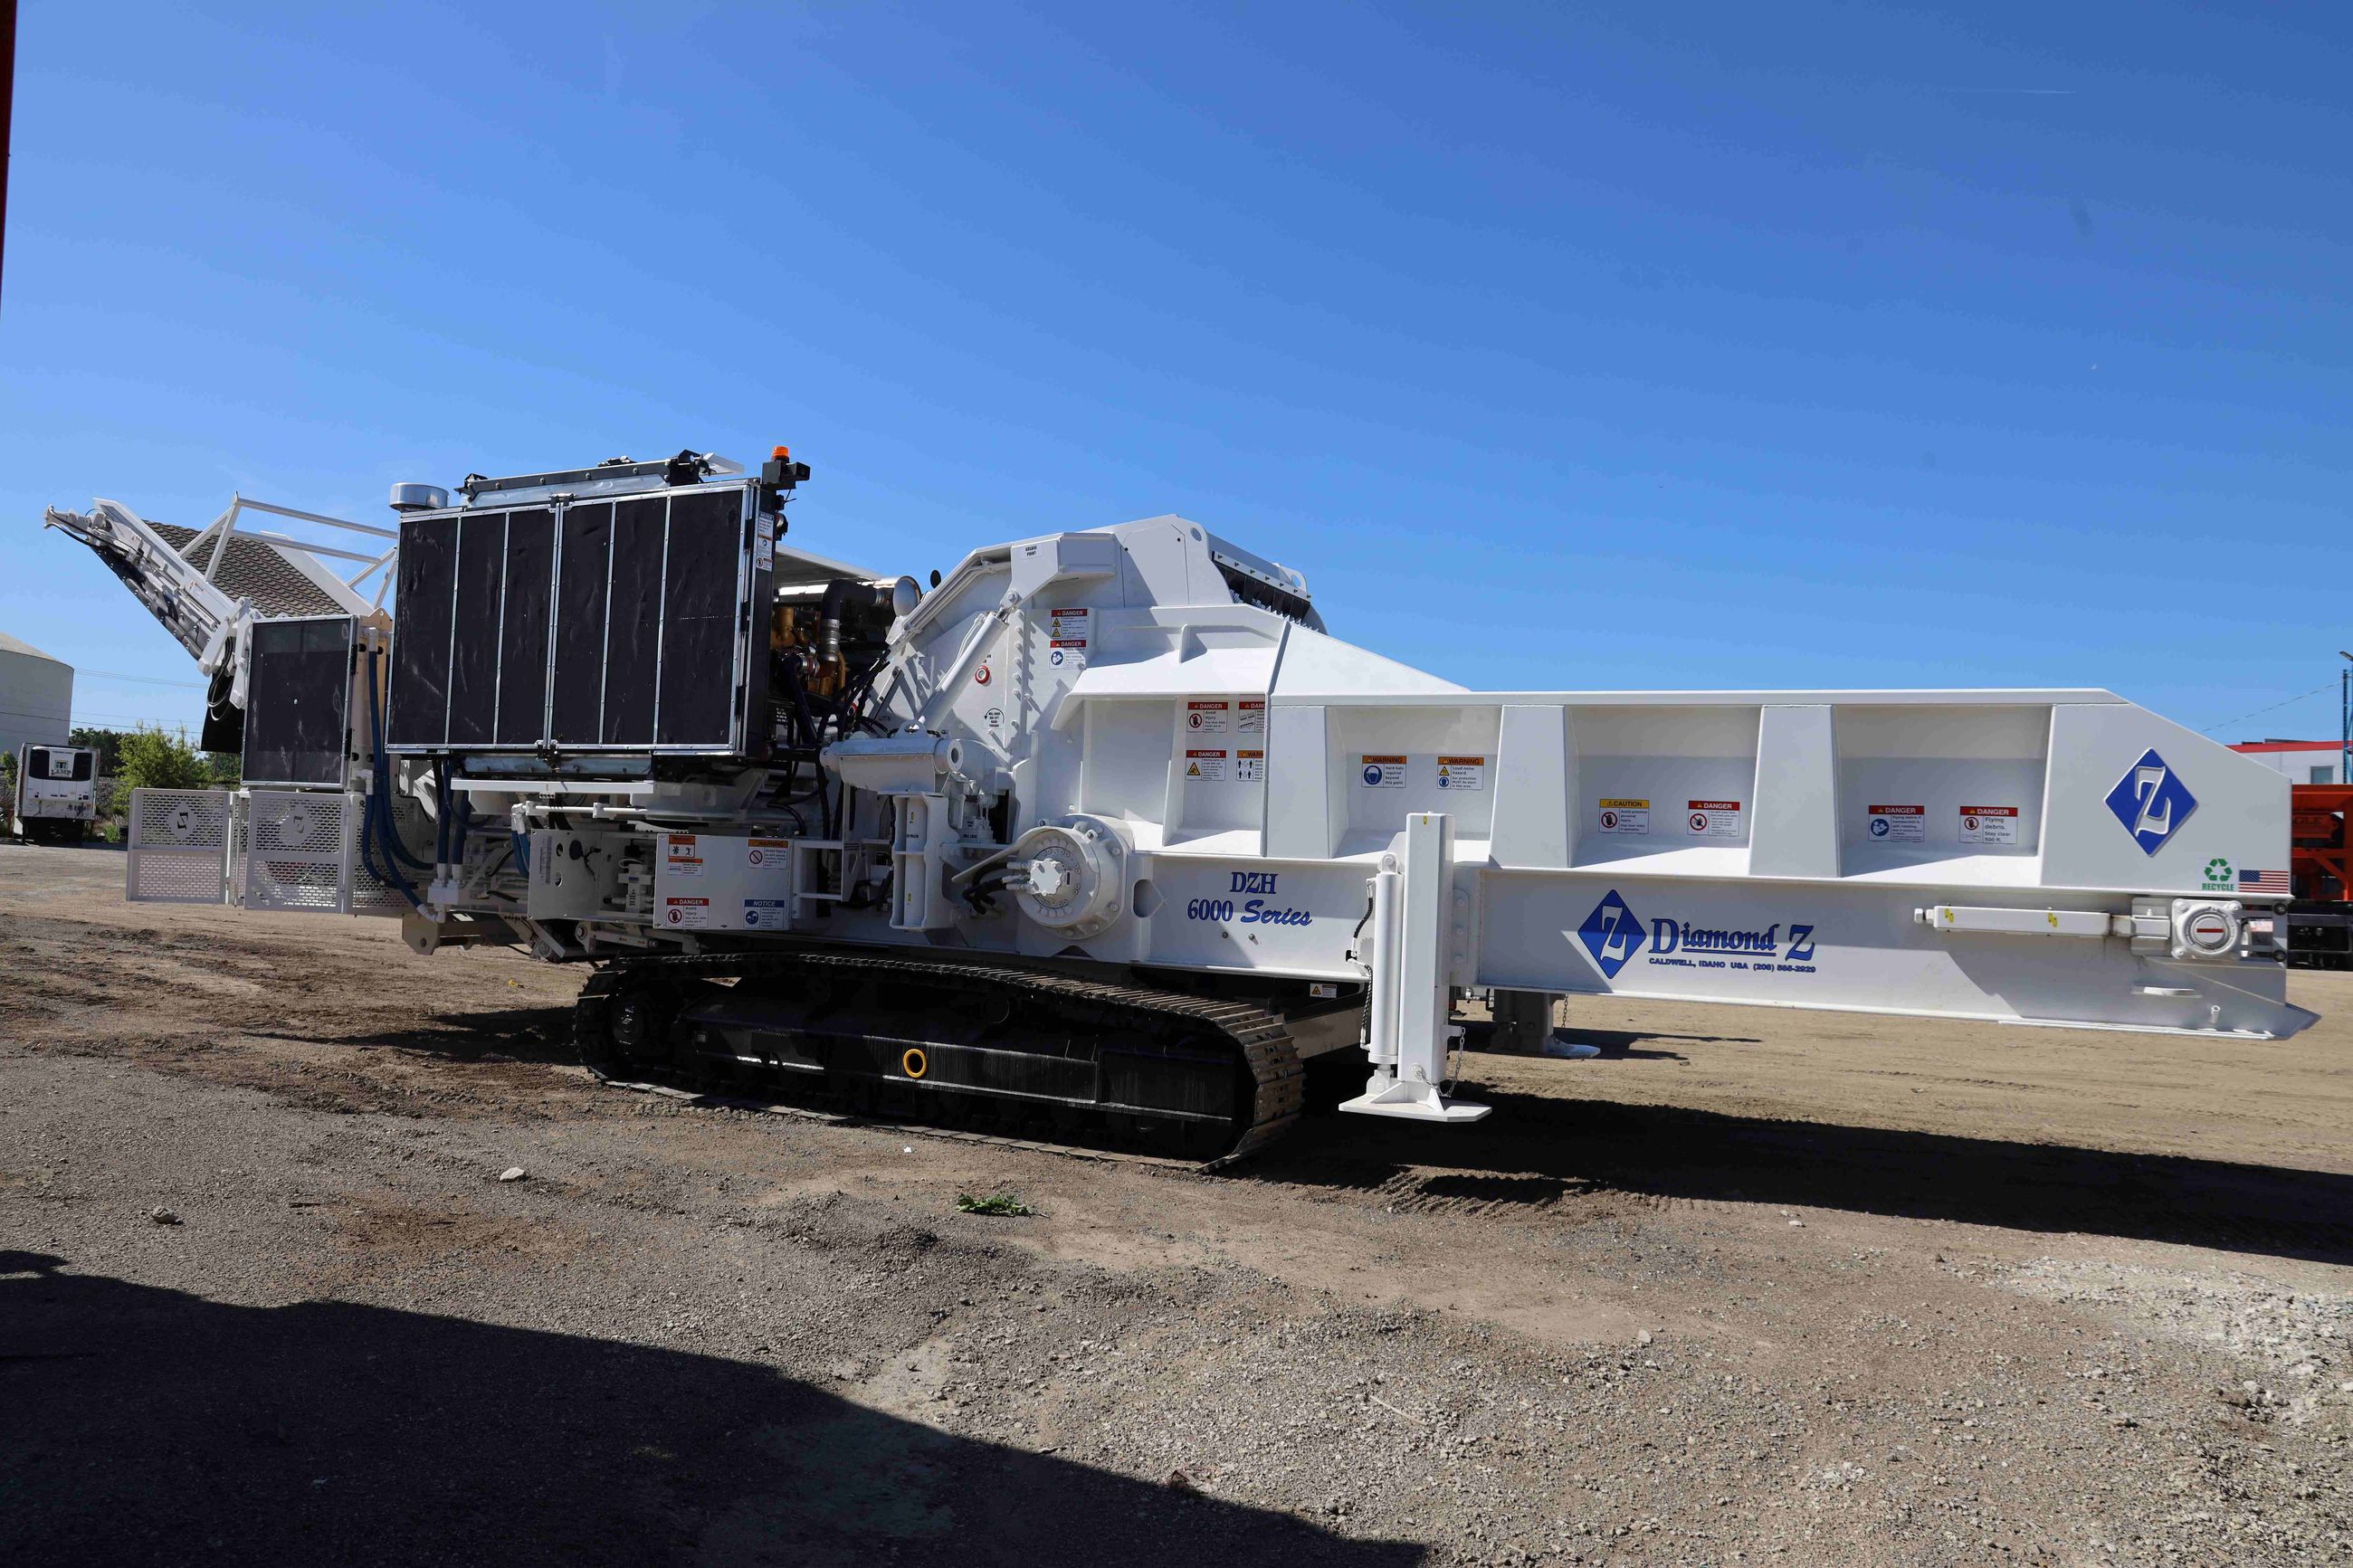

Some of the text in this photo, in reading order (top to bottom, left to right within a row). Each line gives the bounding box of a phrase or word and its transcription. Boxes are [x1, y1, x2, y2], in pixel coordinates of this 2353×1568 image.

[1230, 872, 1279, 894] DZH
[2202, 883, 2234, 891] RECYCLE
[1187, 898, 1312, 926] 6000 Series
[1648, 918, 1815, 962] Diamond Z
[1649, 958, 1697, 967] CALDWELL,
[1699, 960, 1726, 968] IDAHO
[1753, 964, 1775, 972] (208)
